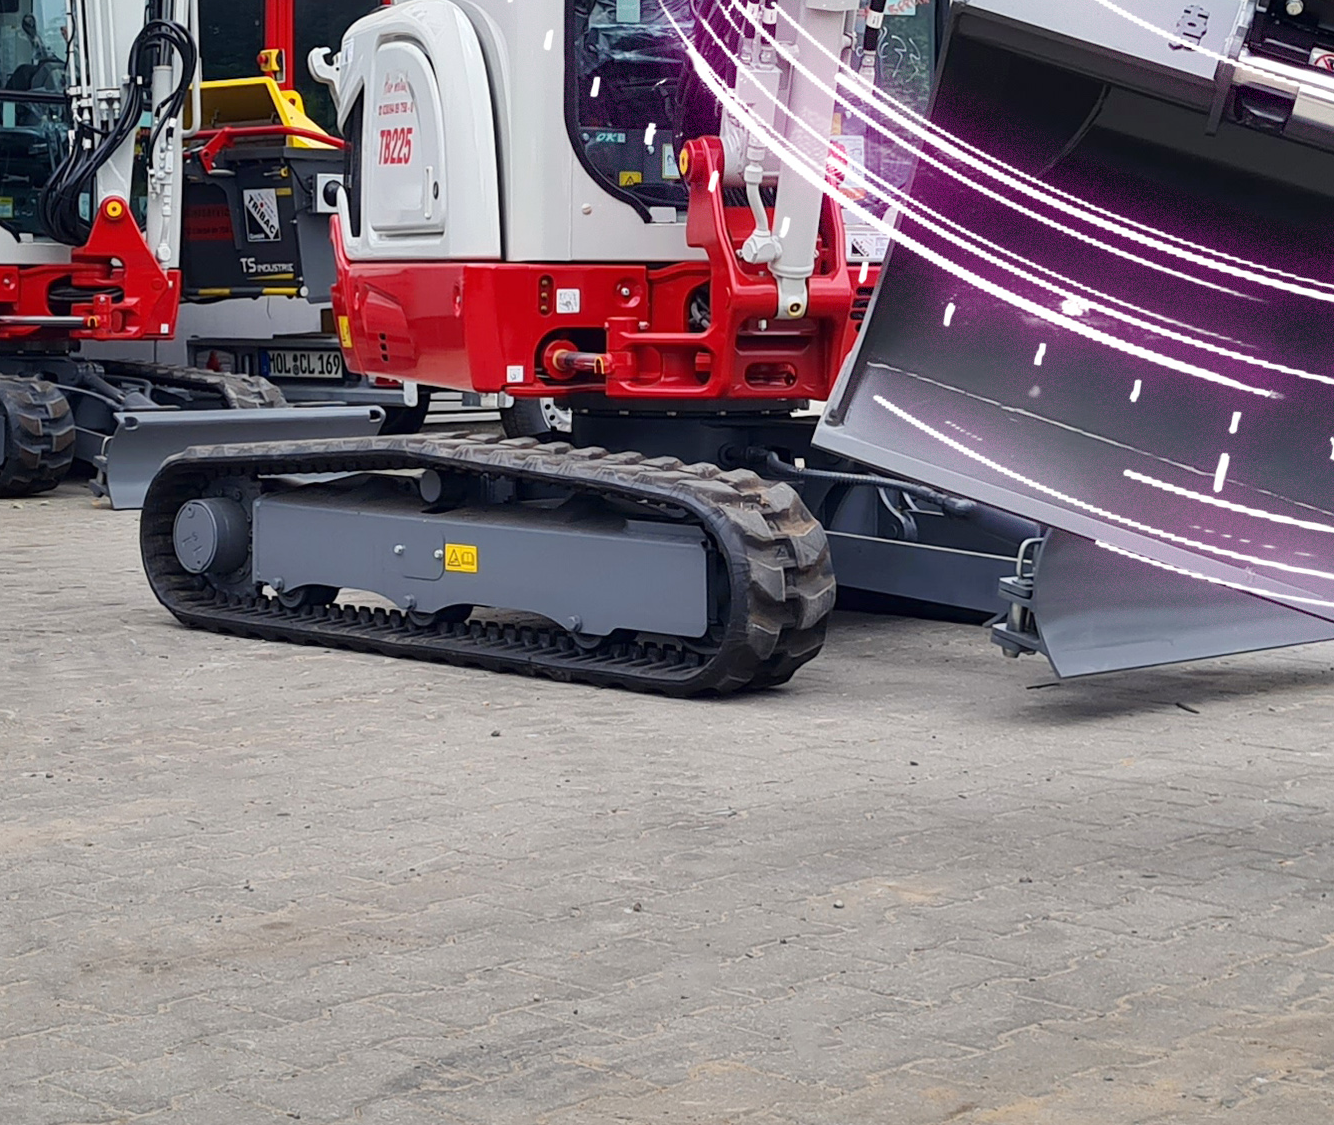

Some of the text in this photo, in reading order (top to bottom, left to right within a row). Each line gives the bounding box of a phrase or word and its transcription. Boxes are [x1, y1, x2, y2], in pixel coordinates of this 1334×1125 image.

[379, 127, 413, 165] TB225
[247, 195, 276, 235] TRIBAC
[240, 257, 256, 273] TS
[299, 353, 315, 374] CL
[318, 353, 340, 375] 169
